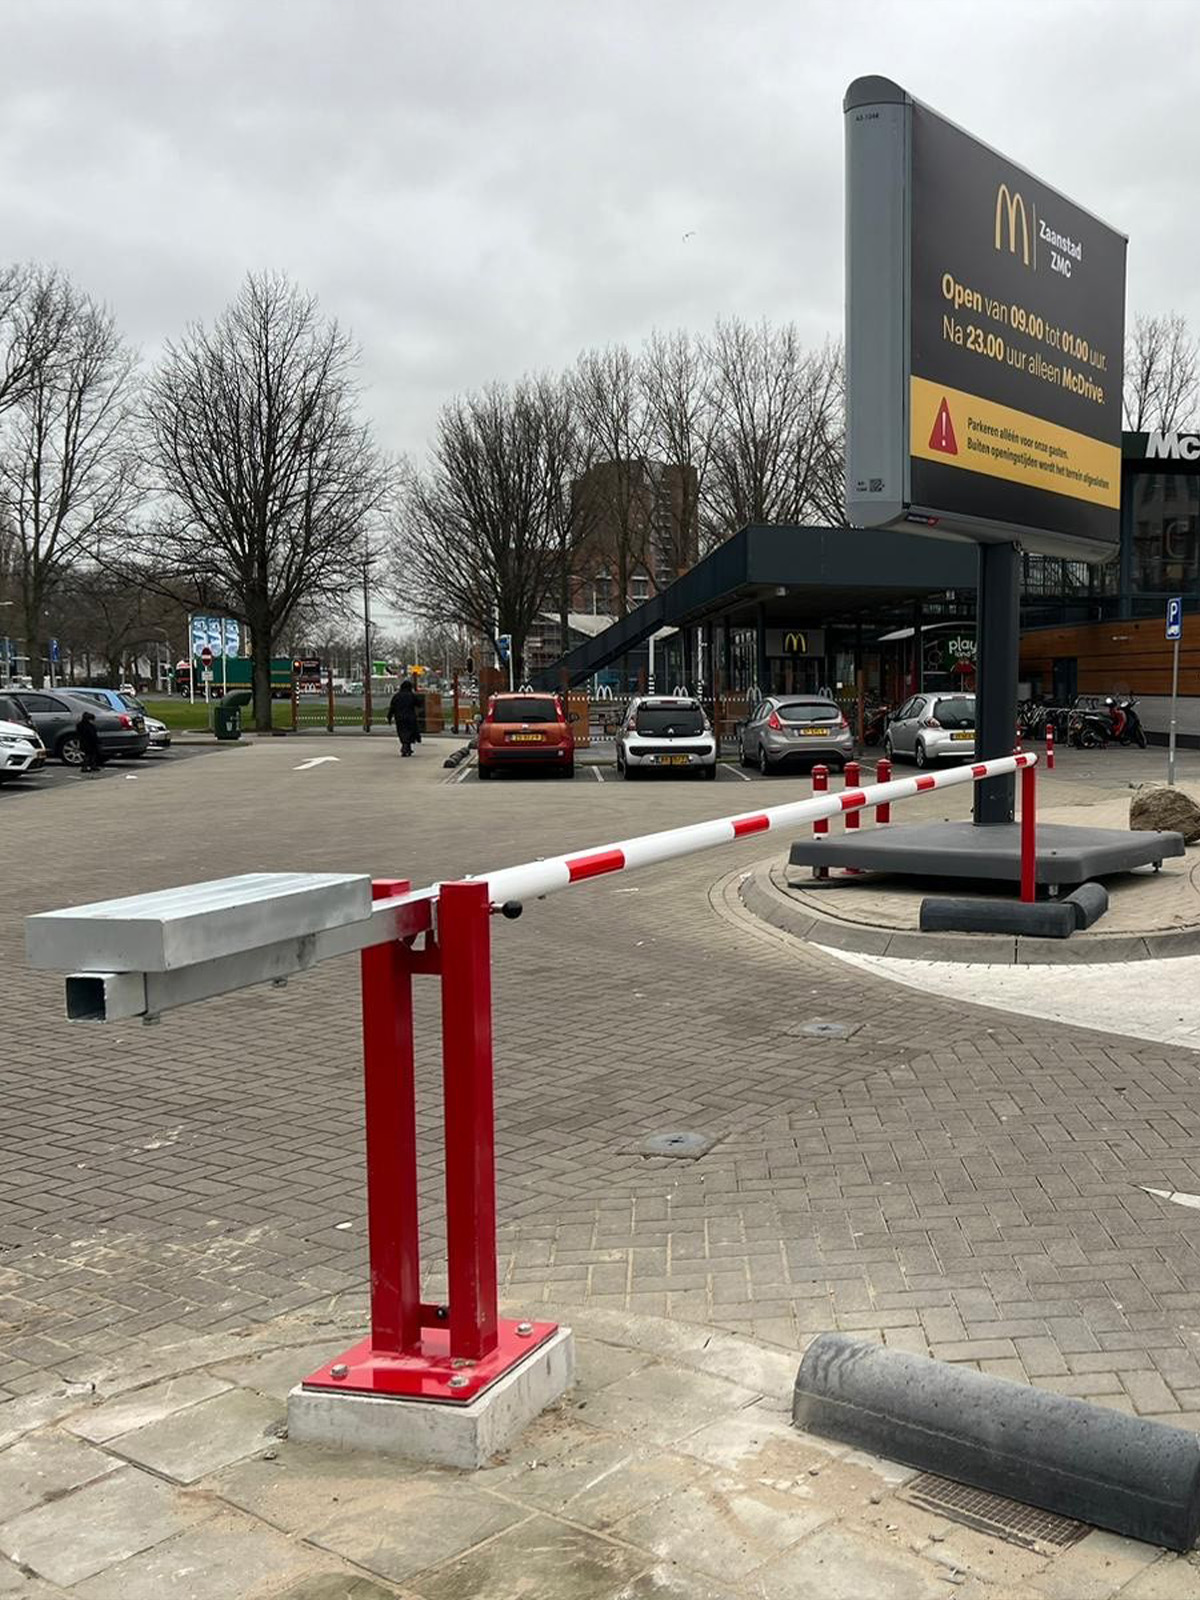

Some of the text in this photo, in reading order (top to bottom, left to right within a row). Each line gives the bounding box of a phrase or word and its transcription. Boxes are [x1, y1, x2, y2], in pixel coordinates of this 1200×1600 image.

[1039, 219, 1082, 261] Zaanstad
[1050, 250, 1071, 278] ZMC
[942, 273, 982, 313] Open
[984, 298, 1008, 324] van
[1010, 305, 1044, 340] 09.00
[1045, 322, 1061, 350] tot
[1062, 330, 1089, 362] 01.00
[943, 314, 1105, 405] Na 23.00 uur alleen McDrive.
[967, 416, 999, 438] Parkeren
[1020, 436, 1034, 449] voor
[967, 436, 990, 455] Buiten
[991, 446, 1037, 469] openingstijden
[948, 636, 977, 655] play
